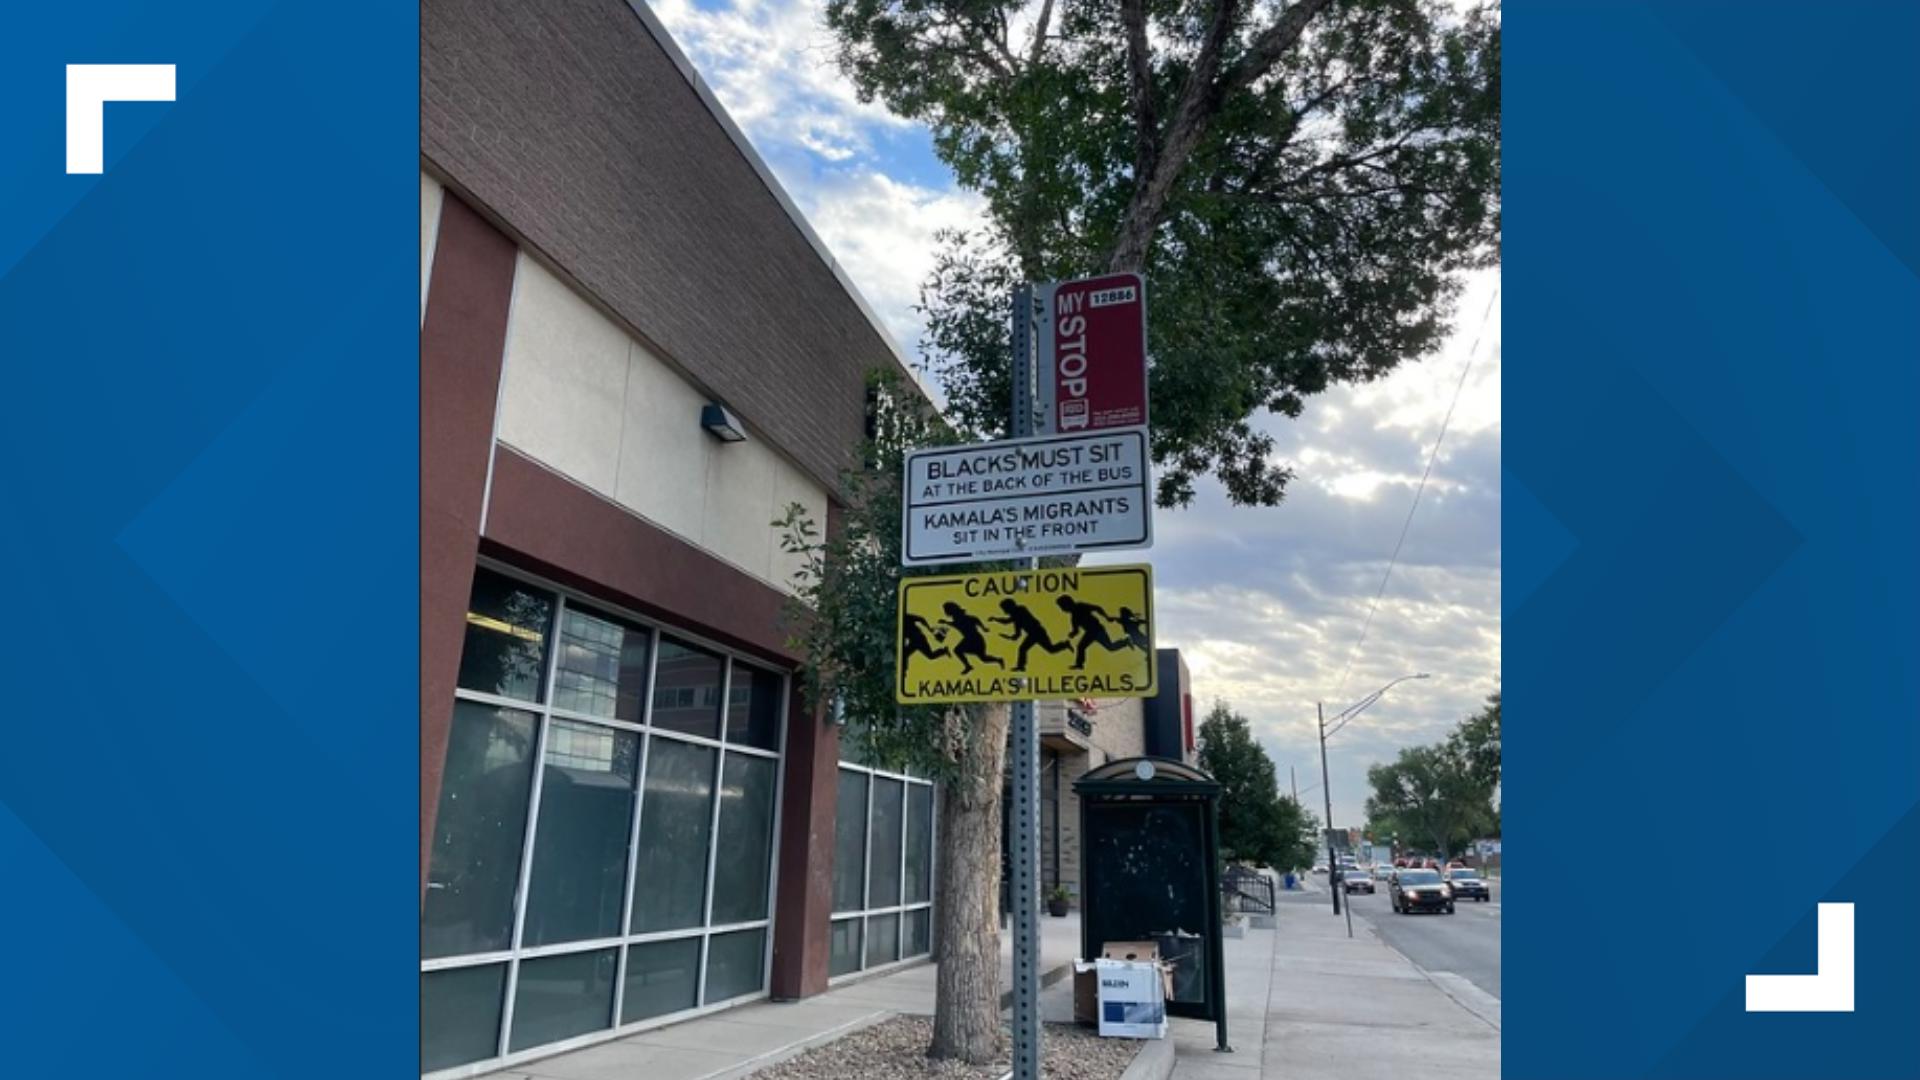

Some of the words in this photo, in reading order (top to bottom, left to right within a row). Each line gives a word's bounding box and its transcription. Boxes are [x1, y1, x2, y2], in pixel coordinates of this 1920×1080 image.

[1058, 291, 1085, 315] MY
[1059, 315, 1087, 396] STOP
[927, 454, 1017, 480] BLACKS
[1022, 447, 1084, 469] MUST
[1089, 443, 1123, 463] SIT
[923, 484, 941, 498] AT
[947, 480, 977, 495] THE
[983, 476, 1026, 492] BACK
[1032, 473, 1054, 487] OF
[1060, 470, 1092, 485] THE
[1099, 466, 1132, 481] BUS
[924, 507, 1018, 530] KAMALA'S
[1023, 497, 1130, 521] MIGRANTS
[953, 530, 978, 545] SIT
[983, 528, 999, 541] IN
[1004, 524, 1036, 540] THE
[1042, 520, 1099, 536] FRONT
[965, 573, 1079, 597] CAUTION
[919, 678, 1020, 697] KAMALA'S
[1027, 674, 1134, 694] ILLEGALS
